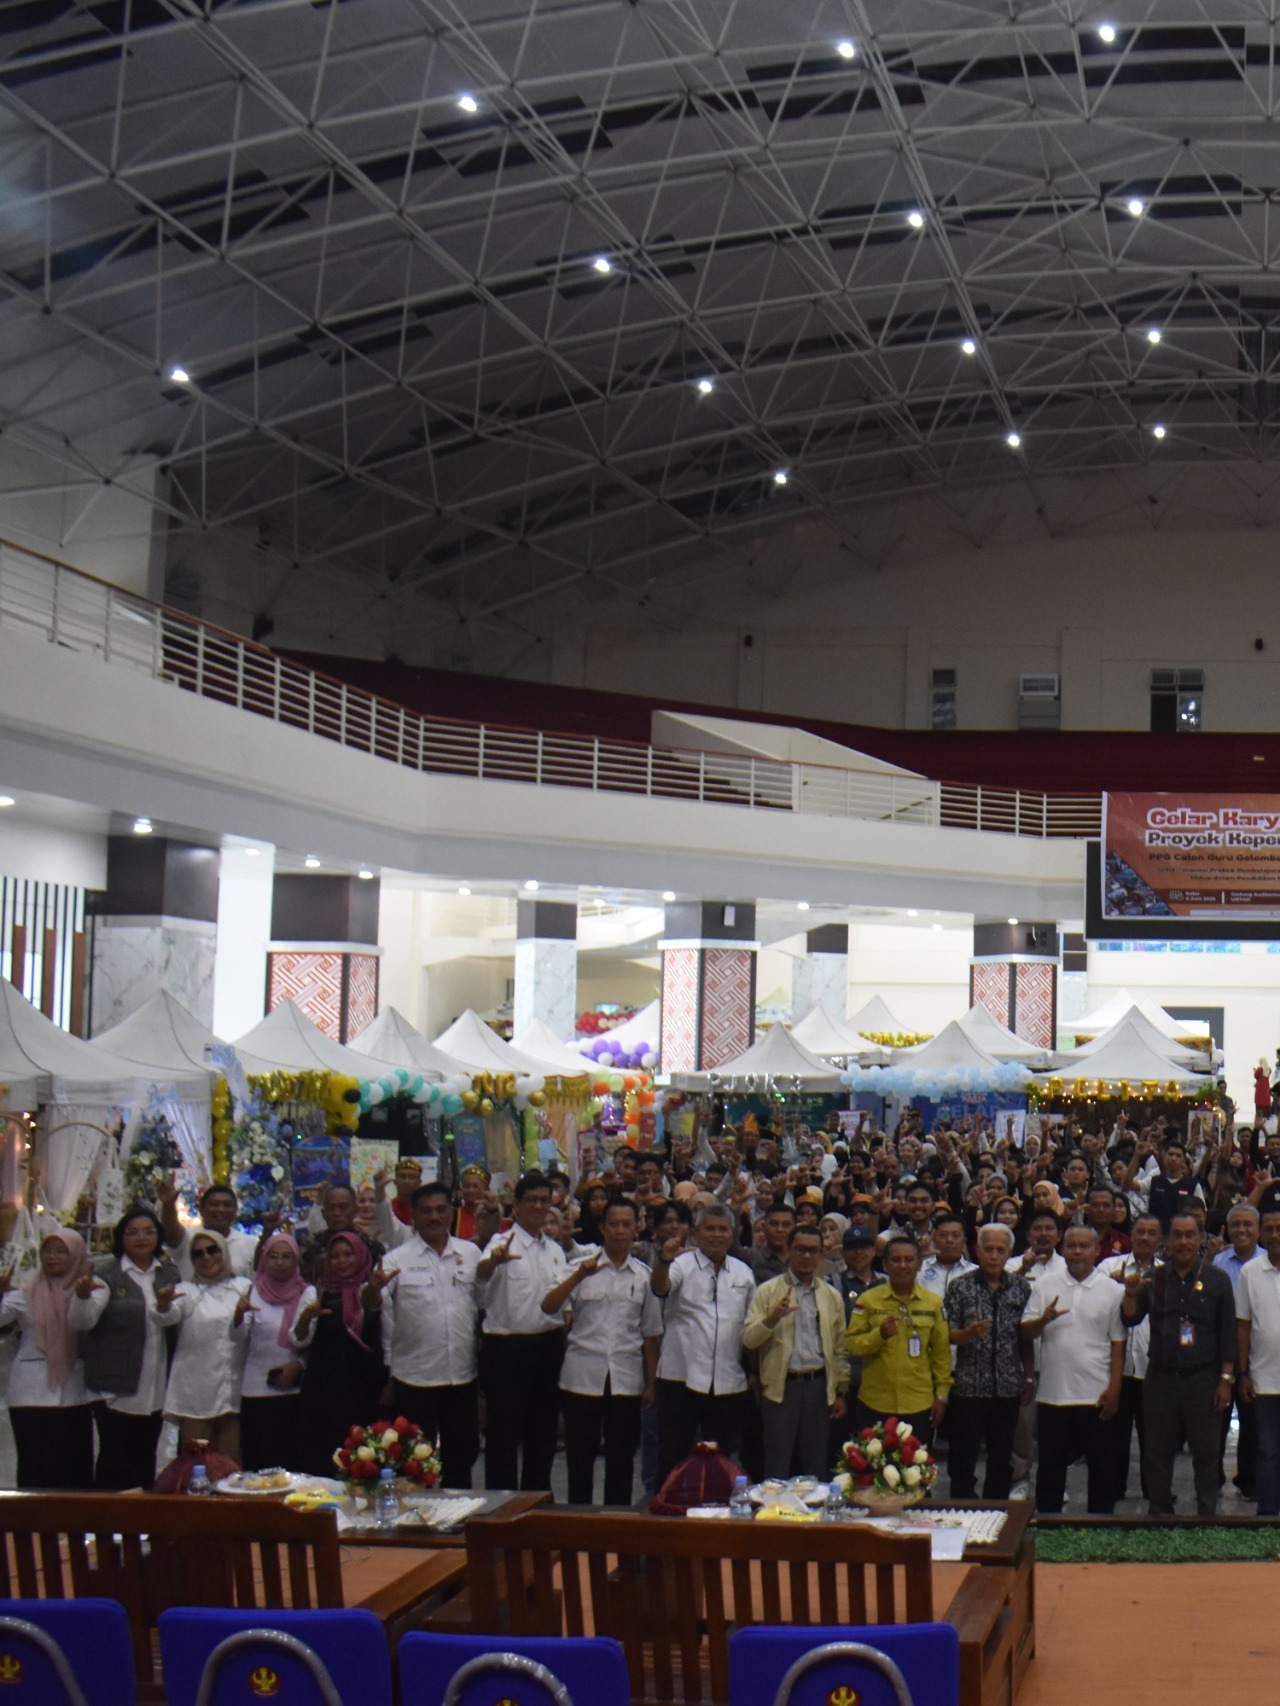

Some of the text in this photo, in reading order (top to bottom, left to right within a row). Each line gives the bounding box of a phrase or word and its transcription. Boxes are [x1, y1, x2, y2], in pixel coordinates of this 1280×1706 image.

[1149, 809, 1215, 827] Gelar
[1148, 831, 1220, 848] Proyek
[1149, 853, 1171, 862] PPG
[1174, 853, 1204, 862] Calon
[1207, 853, 1233, 862] Guru
[1048, 1077, 1181, 1103] PELITA
